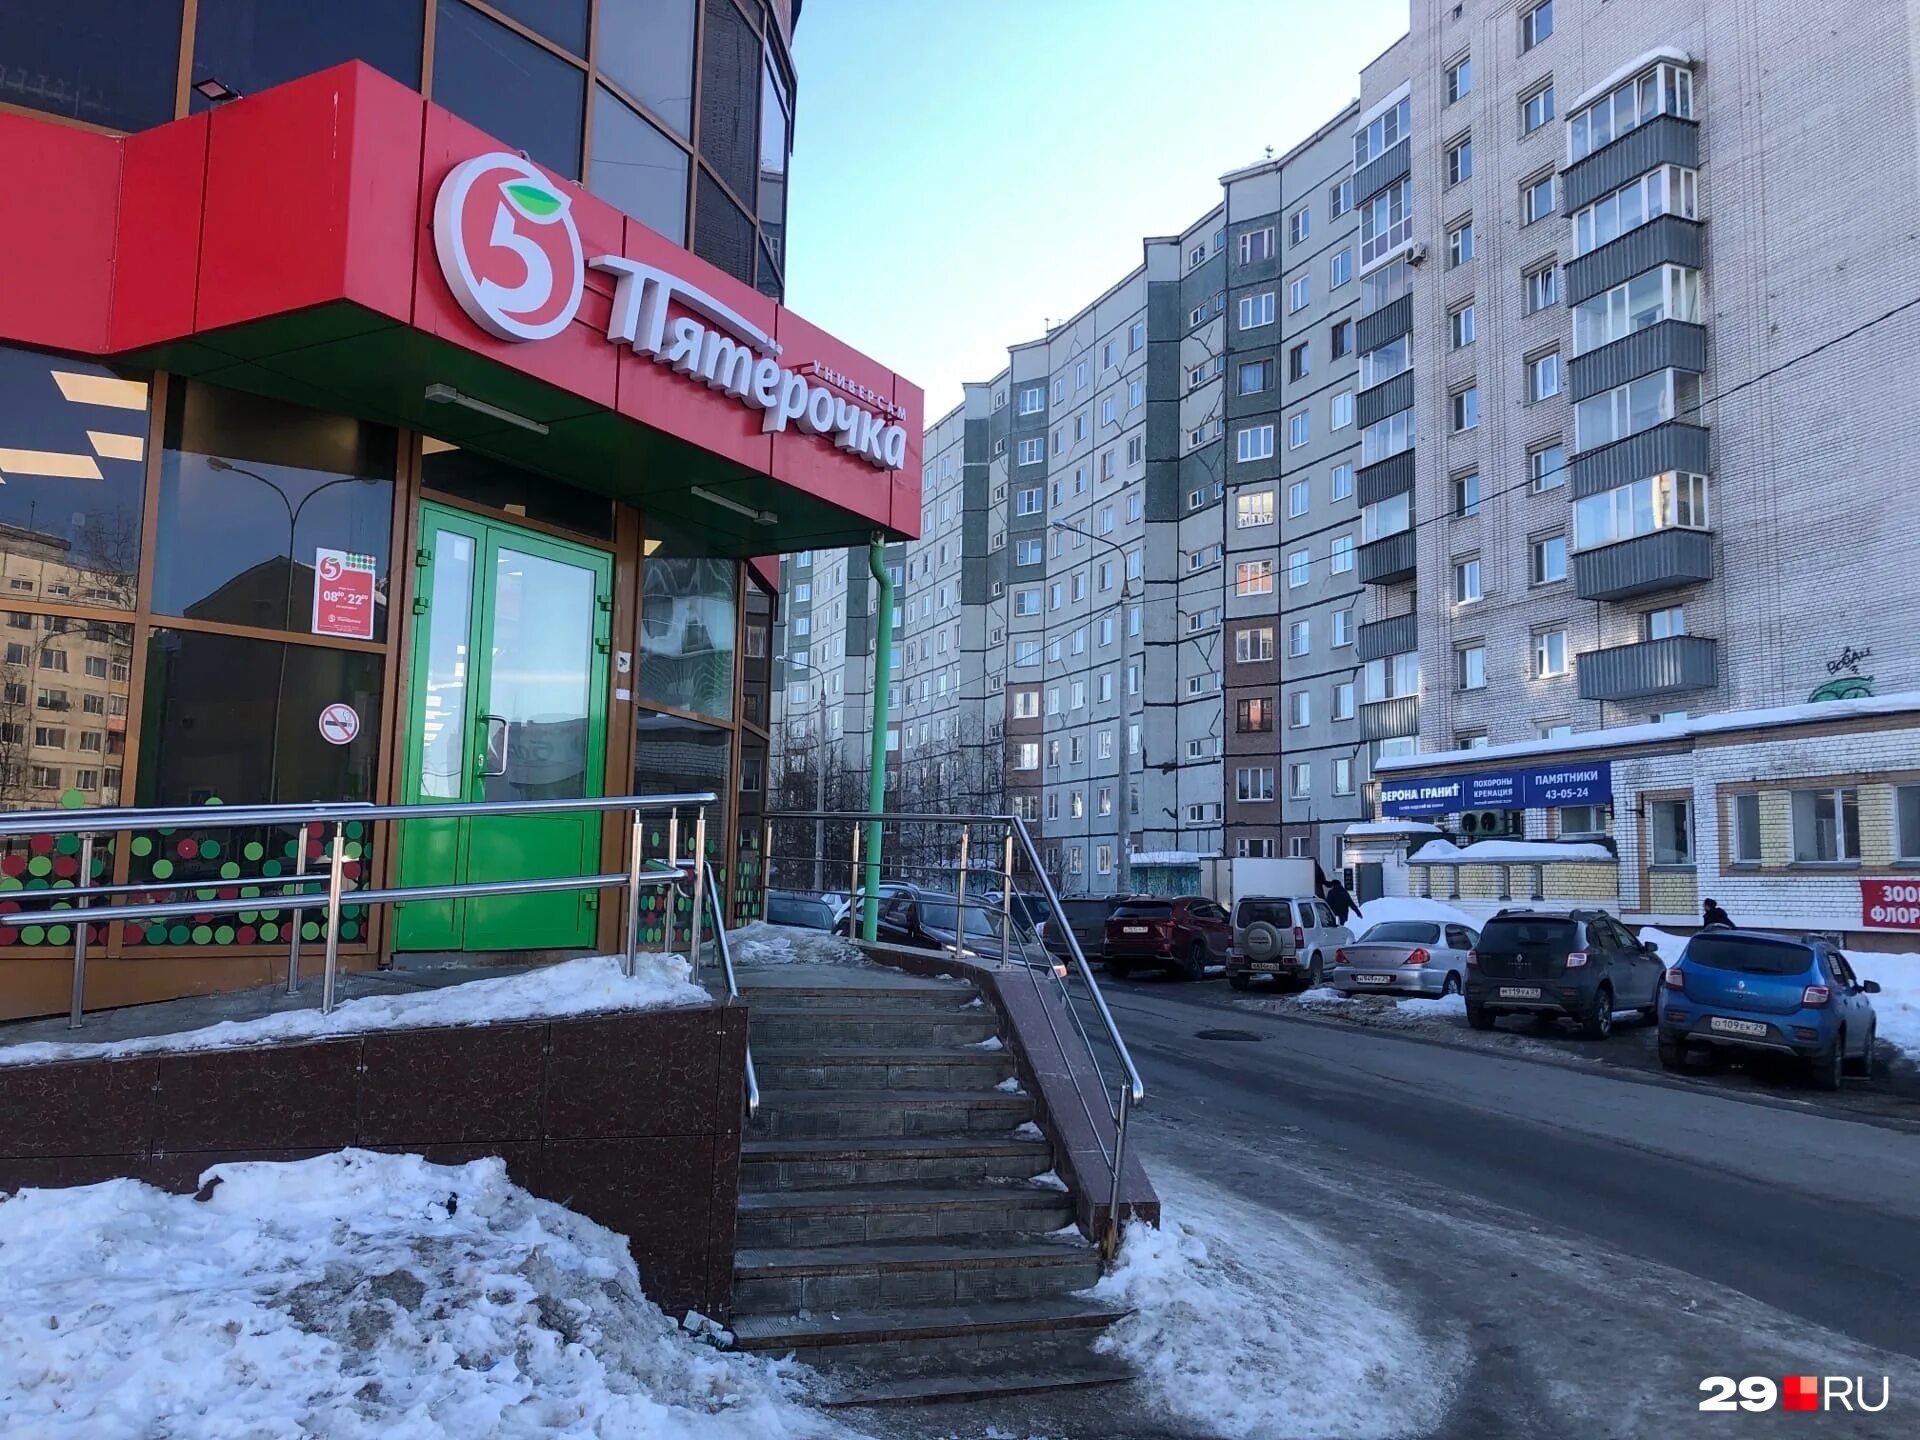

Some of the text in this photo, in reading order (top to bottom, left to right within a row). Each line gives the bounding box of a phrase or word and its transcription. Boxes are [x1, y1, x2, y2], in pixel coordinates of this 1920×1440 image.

[478, 200, 553, 312] 5
[588, 254, 907, 470] Пятёрочка
[813, 360, 906, 421] УНИВЕРСАМ
[1473, 778, 1513, 788] ПОХОРОНЫ
[1535, 770, 1598, 786] ПАМЯТНИКИ
[1381, 789, 1419, 802] ВЕРОНА
[1473, 788, 1513, 798] КРЕМАЦИЯ
[1545, 787, 1588, 799] 43-05-24
[1882, 885, 1920, 903] ЗОО
